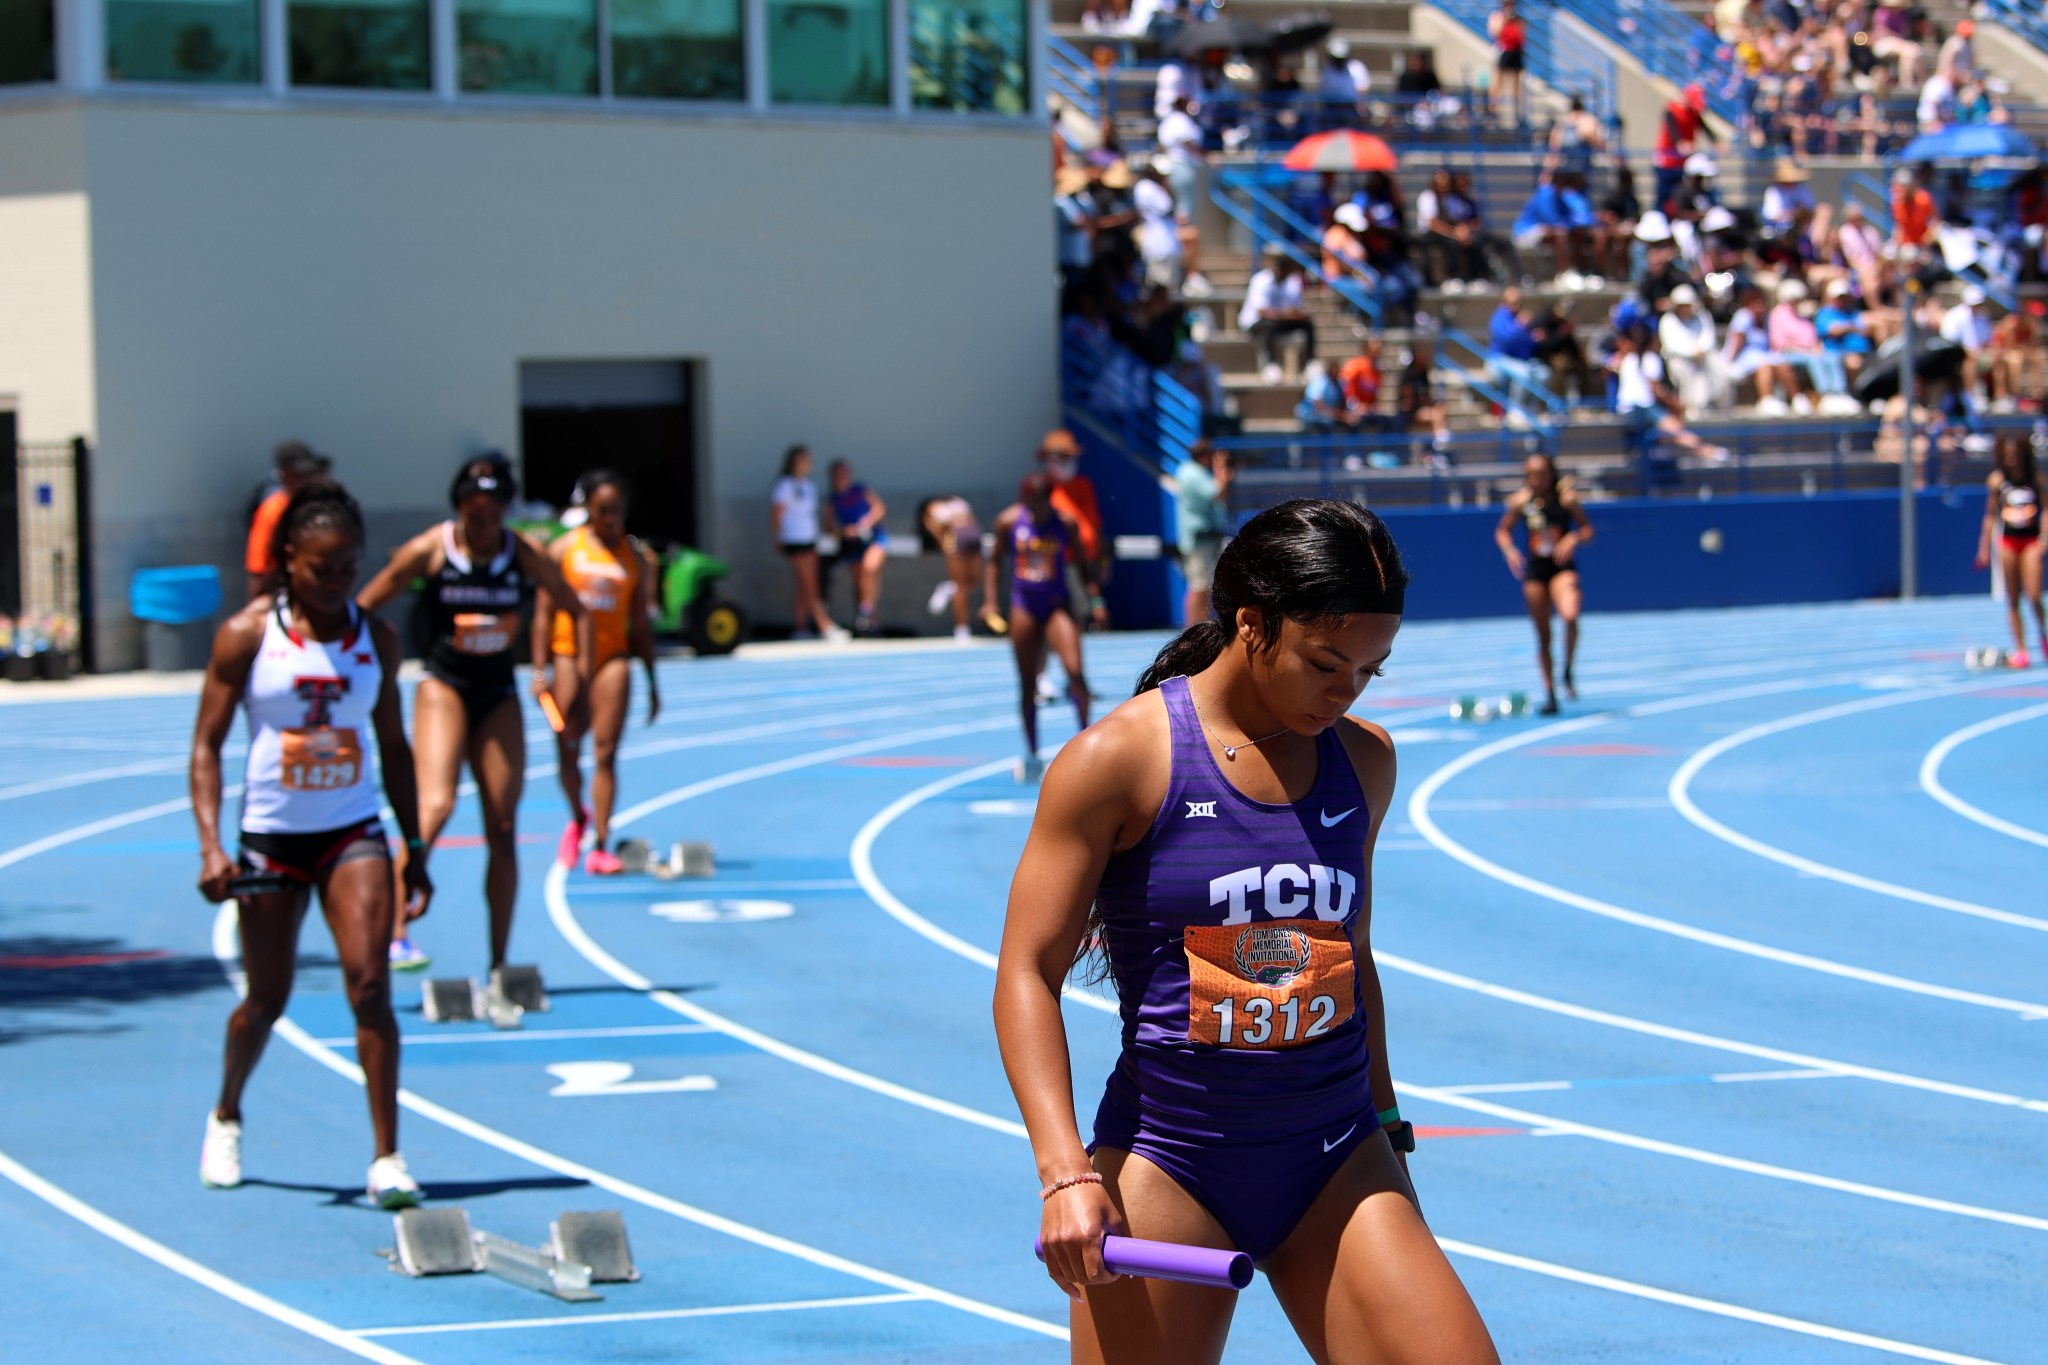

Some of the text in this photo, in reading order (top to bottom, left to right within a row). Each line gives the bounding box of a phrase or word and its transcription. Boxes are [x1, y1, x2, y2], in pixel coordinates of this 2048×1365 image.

[1209, 863, 1356, 926] TCU
[1252, 928, 1292, 940] TOM JONES
[1252, 938, 1292, 950] MEMORIAL
[1248, 949, 1298, 962] INVITATIONAL
[1212, 995, 1337, 1044] 1312
